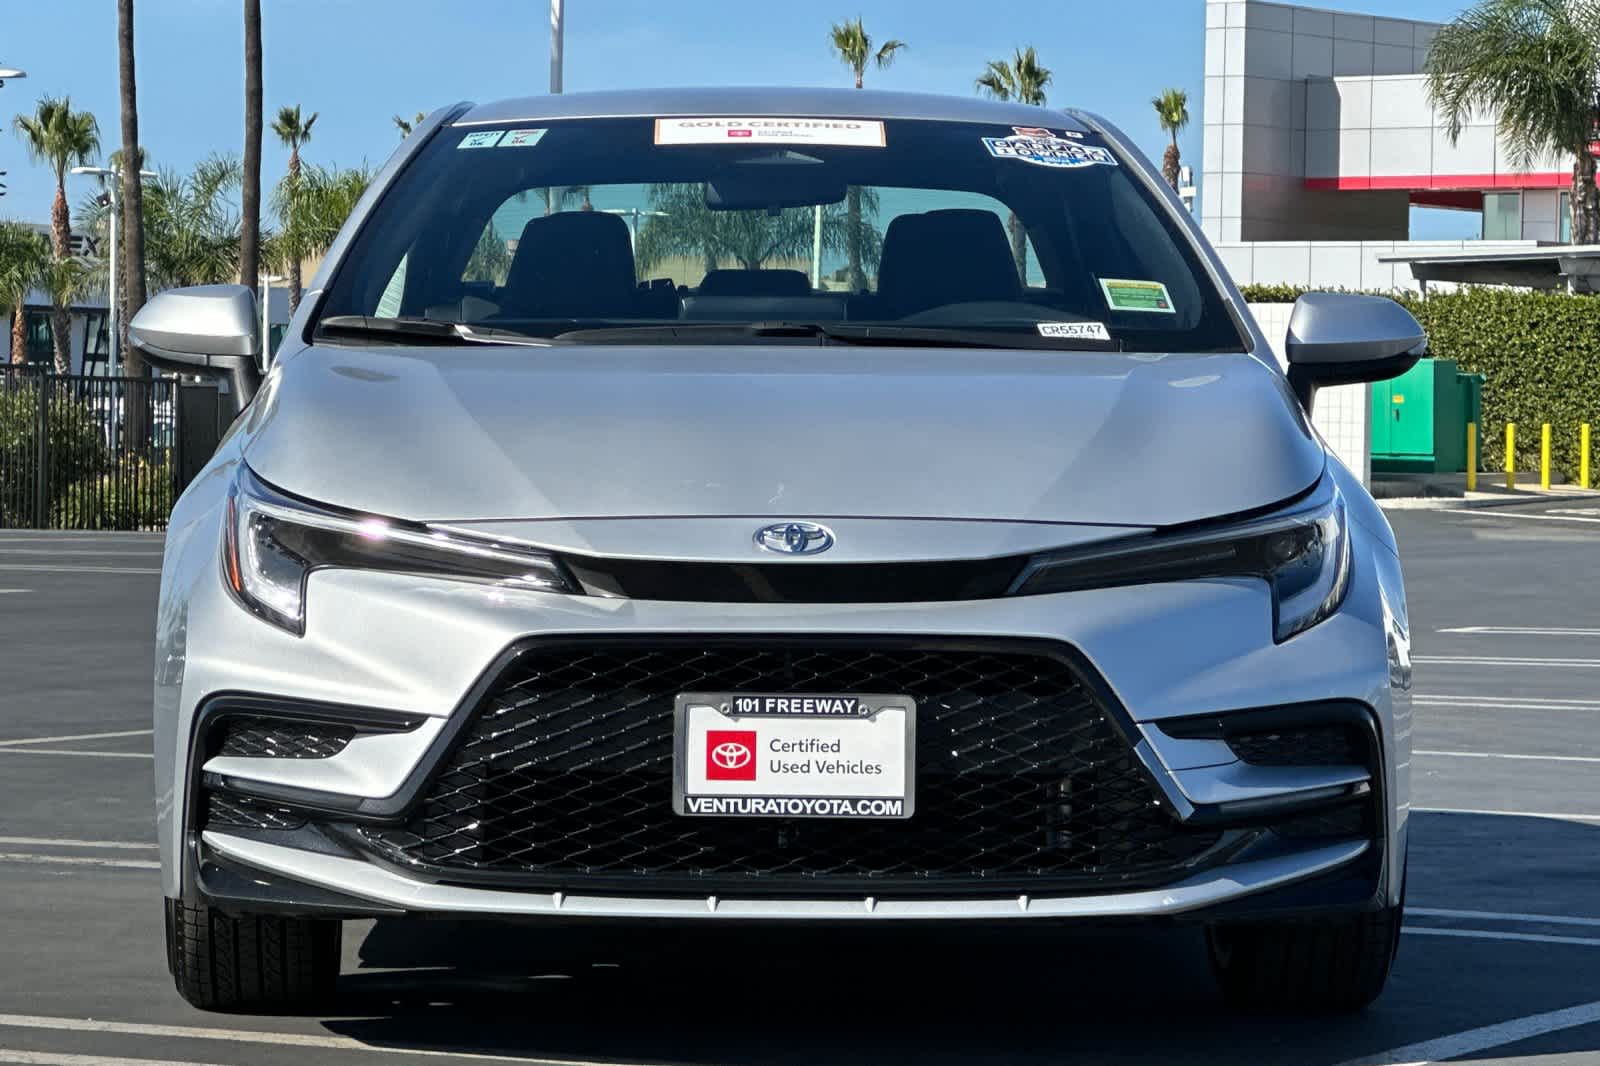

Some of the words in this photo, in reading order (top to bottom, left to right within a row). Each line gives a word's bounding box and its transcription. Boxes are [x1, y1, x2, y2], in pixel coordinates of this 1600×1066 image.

[678, 121, 743, 129] GOLD
[748, 121, 862, 130] CERTIFIED
[1042, 325, 1102, 336] CR55747
[735, 698, 759, 713] 101
[765, 698, 856, 714] FREEWAY
[769, 738, 841, 753] Certified
[769, 760, 811, 774] Used
[815, 760, 882, 775] Vehicles
[687, 798, 902, 816] VENTURATOYOTA.COM
